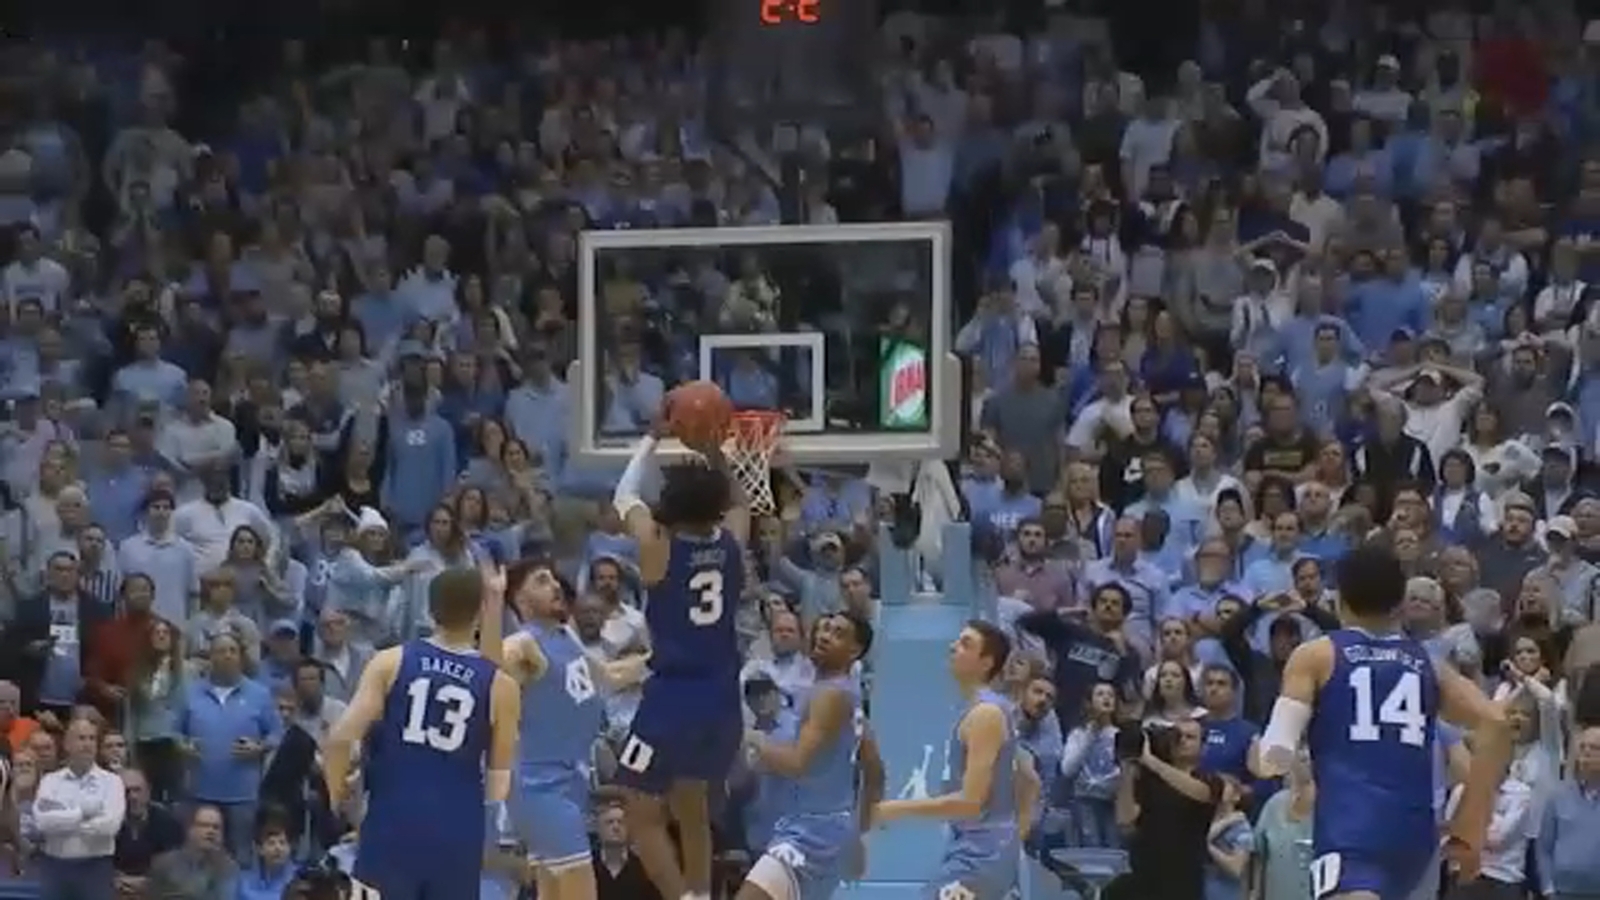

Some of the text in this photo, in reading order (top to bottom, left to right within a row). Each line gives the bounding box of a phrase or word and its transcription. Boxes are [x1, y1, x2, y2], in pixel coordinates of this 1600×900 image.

[689, 570, 723, 625] 3
[421, 657, 475, 684] BAKER
[403, 677, 476, 752] 13
[1349, 666, 1426, 747] 14
